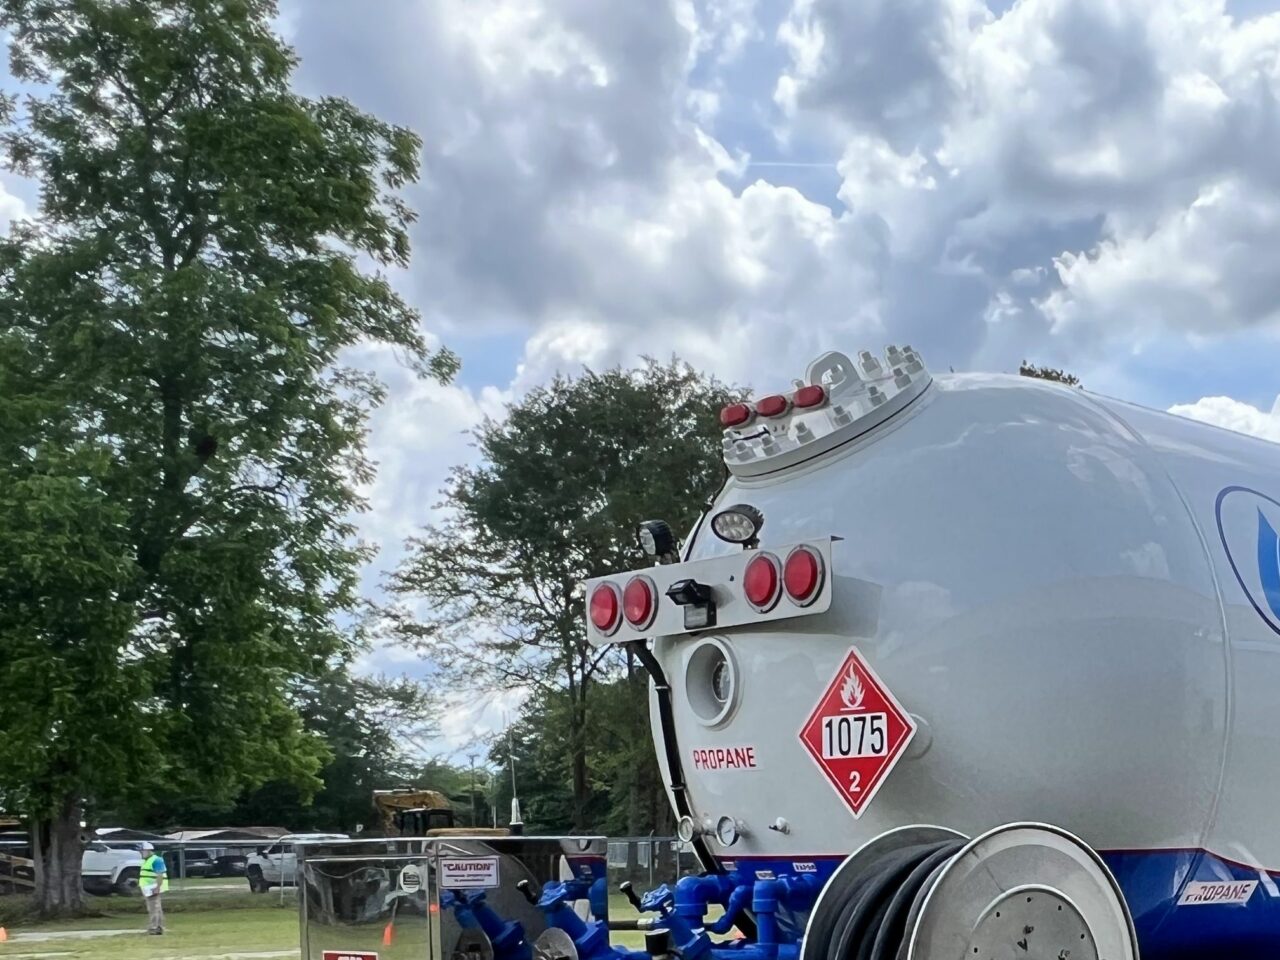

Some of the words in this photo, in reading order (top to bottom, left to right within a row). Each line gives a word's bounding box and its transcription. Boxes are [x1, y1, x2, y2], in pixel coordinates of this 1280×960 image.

[824, 715, 886, 757] 1075
[693, 747, 757, 769] PROPANE
[850, 770, 861, 792] 2
